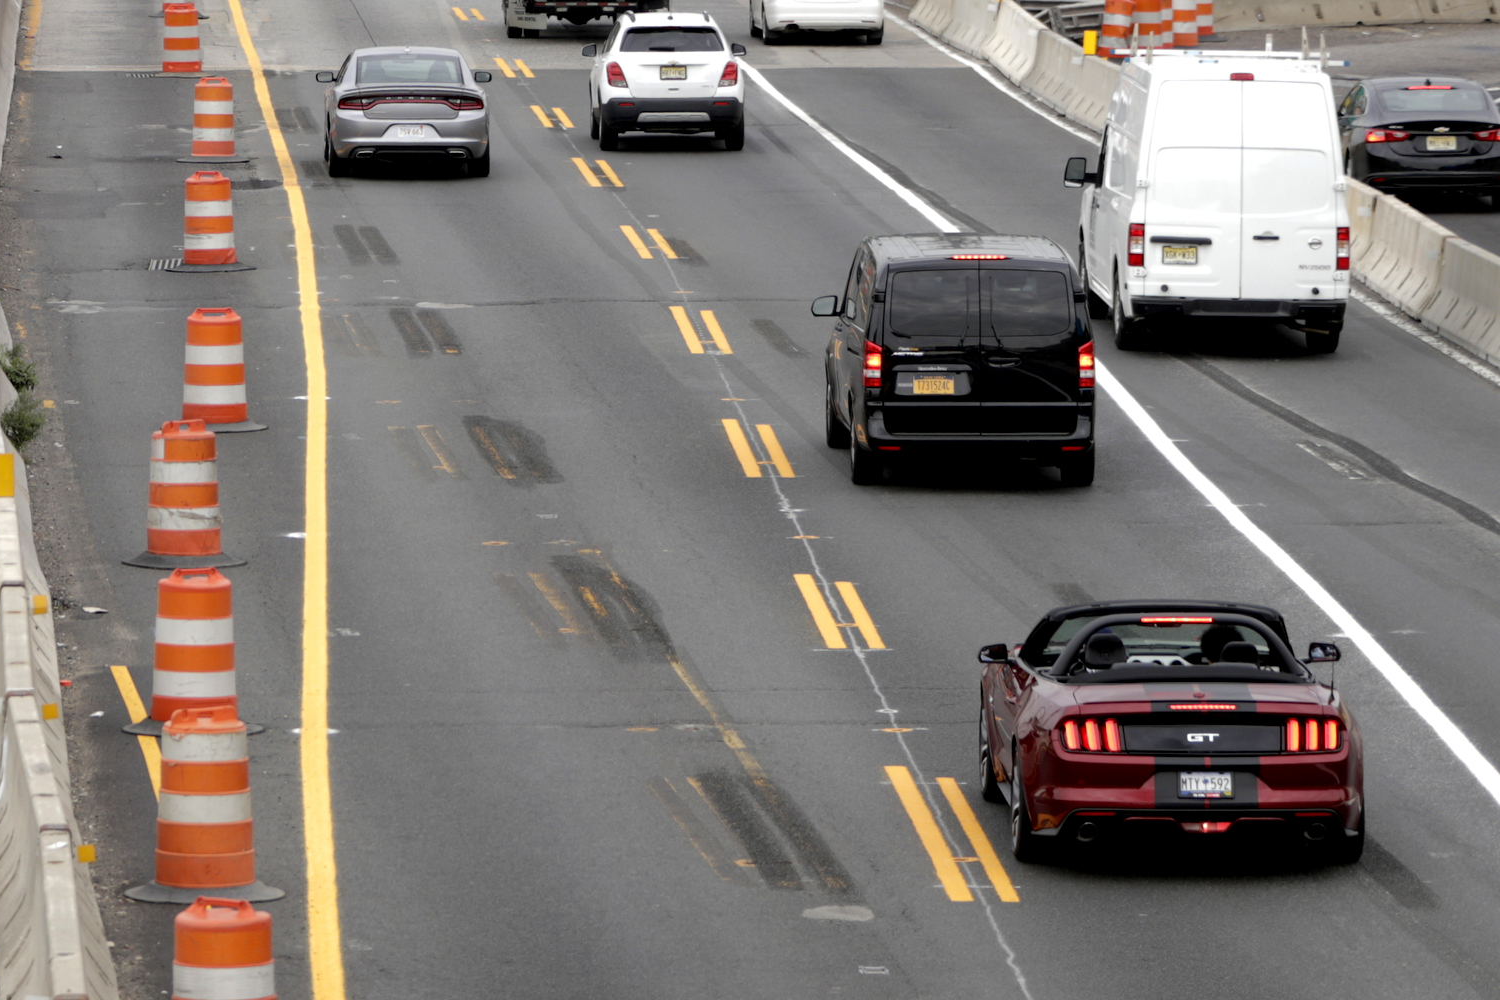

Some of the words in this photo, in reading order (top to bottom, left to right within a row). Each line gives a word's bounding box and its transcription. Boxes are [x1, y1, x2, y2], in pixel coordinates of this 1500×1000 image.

[1187, 733, 1220, 742] GT
[1181, 777, 1199, 790] MTY
[1210, 777, 1229, 790] 592
